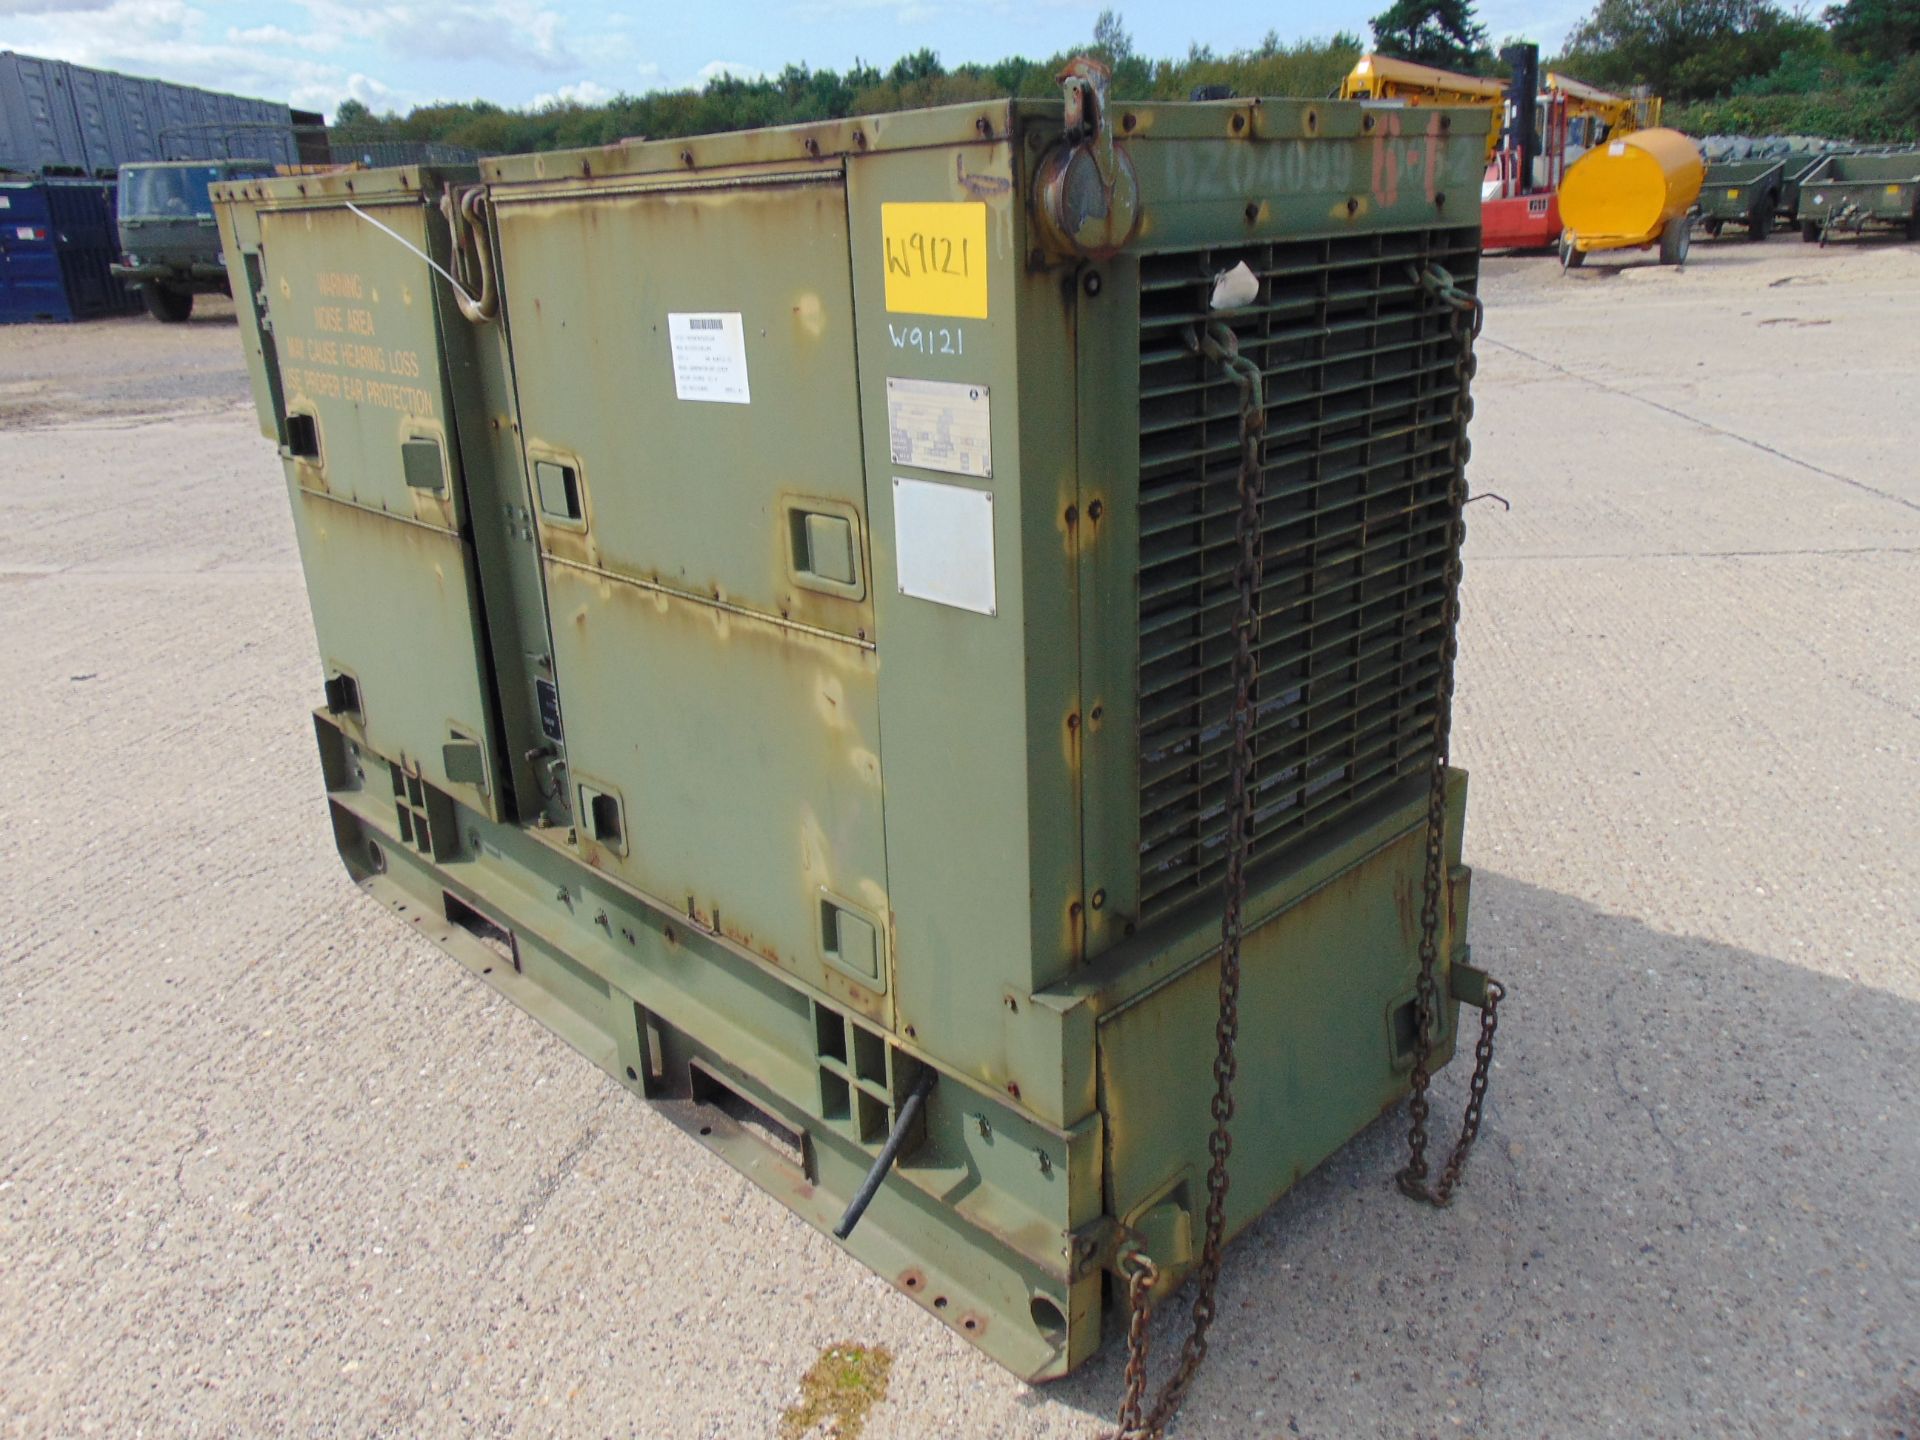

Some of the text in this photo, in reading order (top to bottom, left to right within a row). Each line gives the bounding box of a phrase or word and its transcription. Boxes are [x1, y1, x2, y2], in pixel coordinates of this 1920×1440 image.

[885, 232, 969, 278] W9121
[316, 271, 363, 300] WARNING
[313, 304, 376, 337] NOISE AREA
[888, 323, 963, 355] W9121
[307, 338, 339, 366] CAUSE
[341, 342, 386, 373] HEARING
[388, 350, 419, 379] LOSS
[303, 369, 341, 400] PROPER
[342, 375, 364, 402] EAR
[366, 379, 434, 416] PROTECTION
